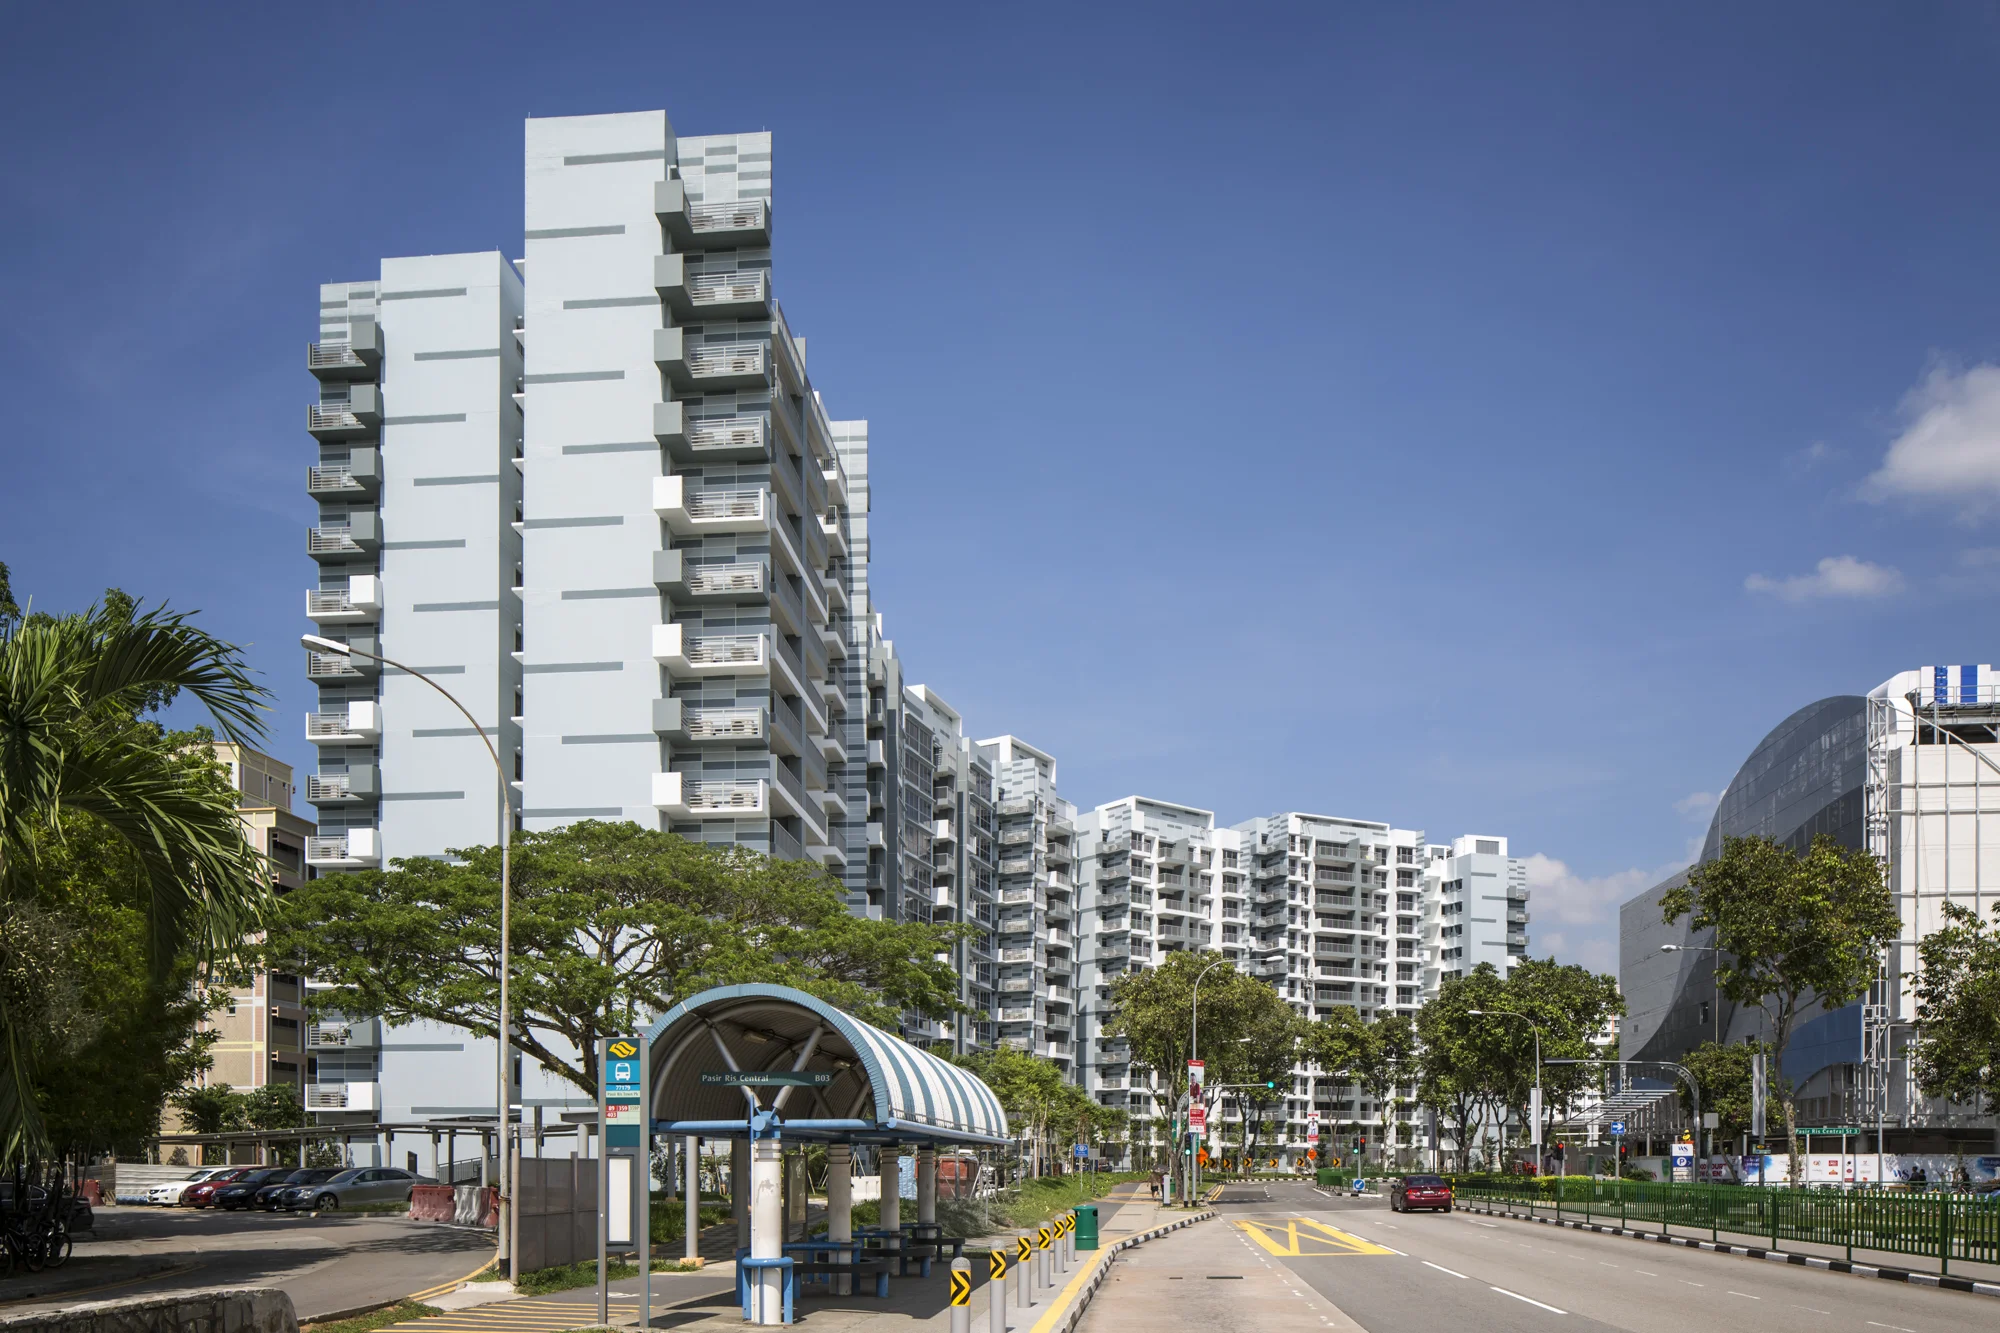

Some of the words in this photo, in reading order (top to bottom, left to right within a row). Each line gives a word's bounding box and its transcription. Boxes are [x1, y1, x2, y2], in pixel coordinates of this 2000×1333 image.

[702, 1074, 721, 1082] Pasir
[725, 1074, 737, 1082] Ris
[740, 1074, 769, 1082] Central
[815, 1074, 830, 1082] B03
